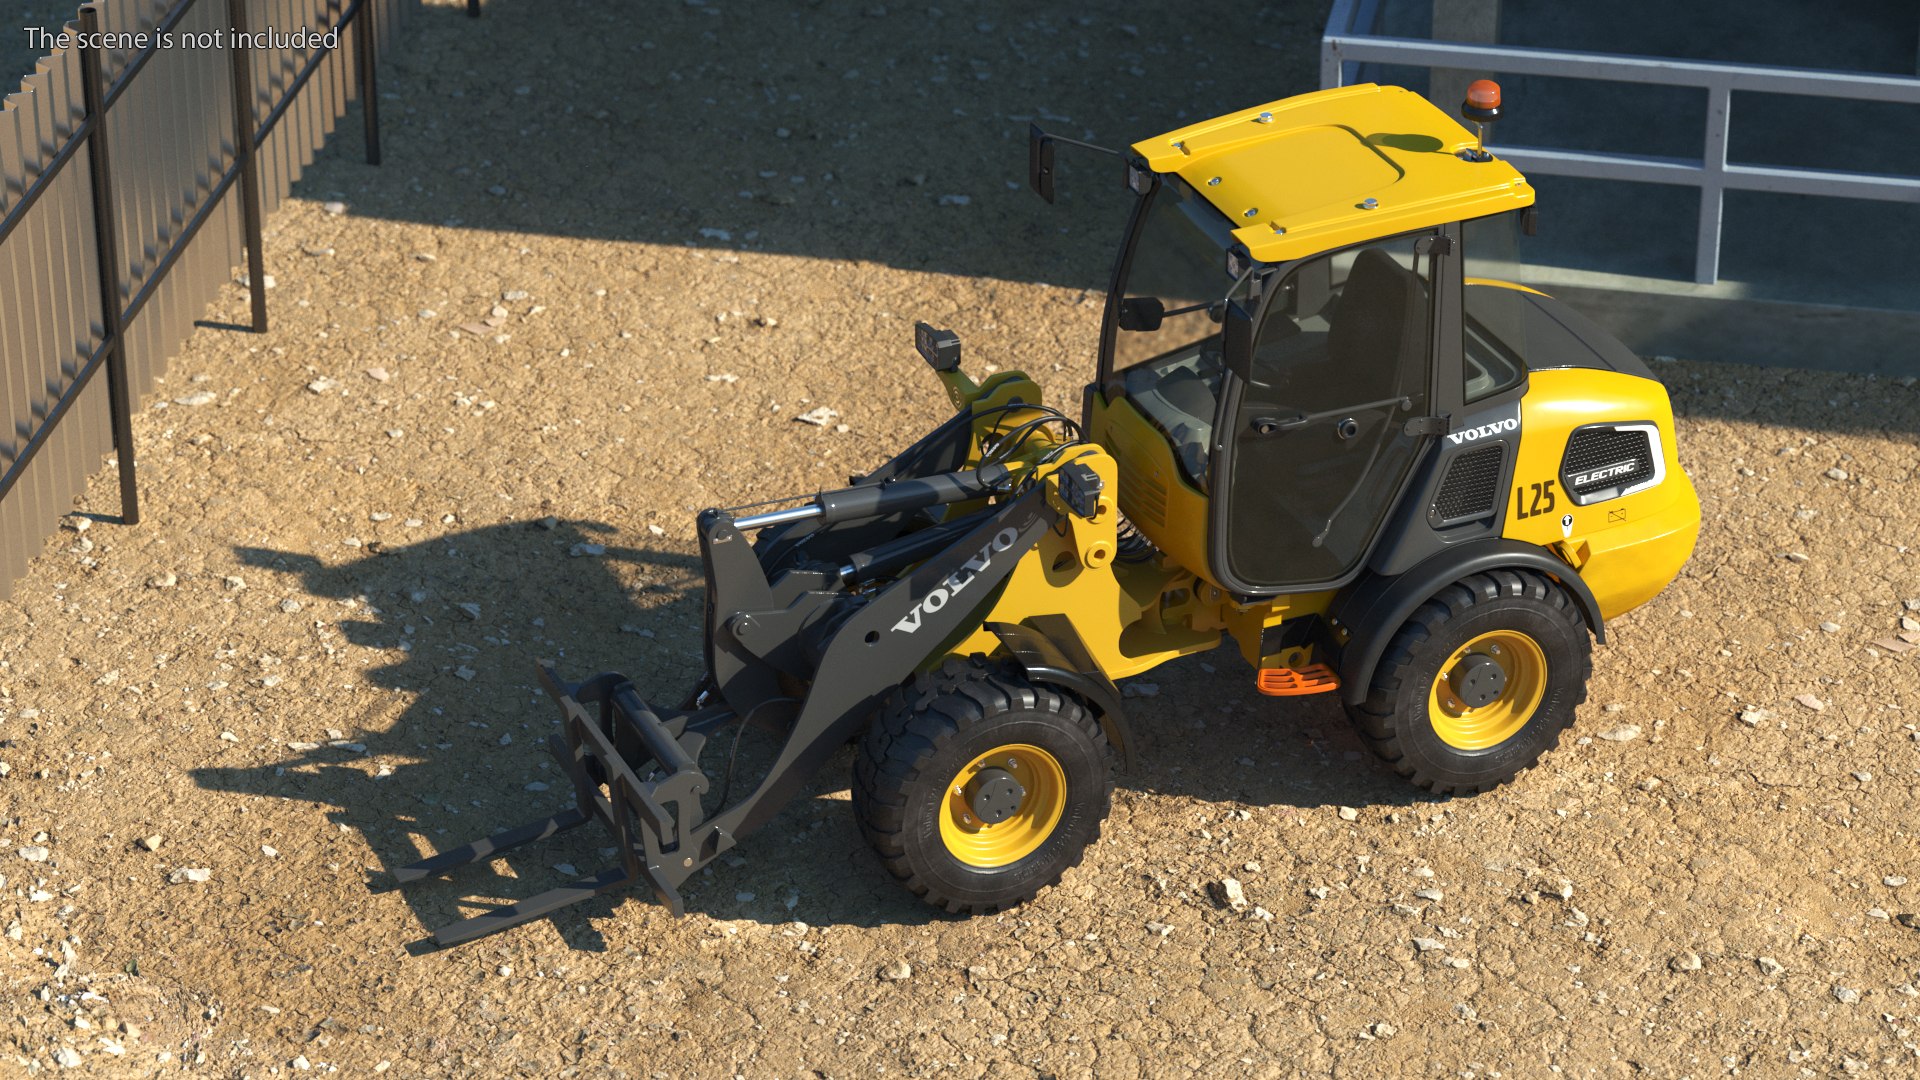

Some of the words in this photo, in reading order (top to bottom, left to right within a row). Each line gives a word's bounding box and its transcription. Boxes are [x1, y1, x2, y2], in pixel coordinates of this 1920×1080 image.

[1447, 418, 1517, 444] VOLVO
[1574, 461, 1636, 486] ELECTRIC
[1517, 479, 1556, 520] L25
[890, 527, 1018, 633] VOLVO
